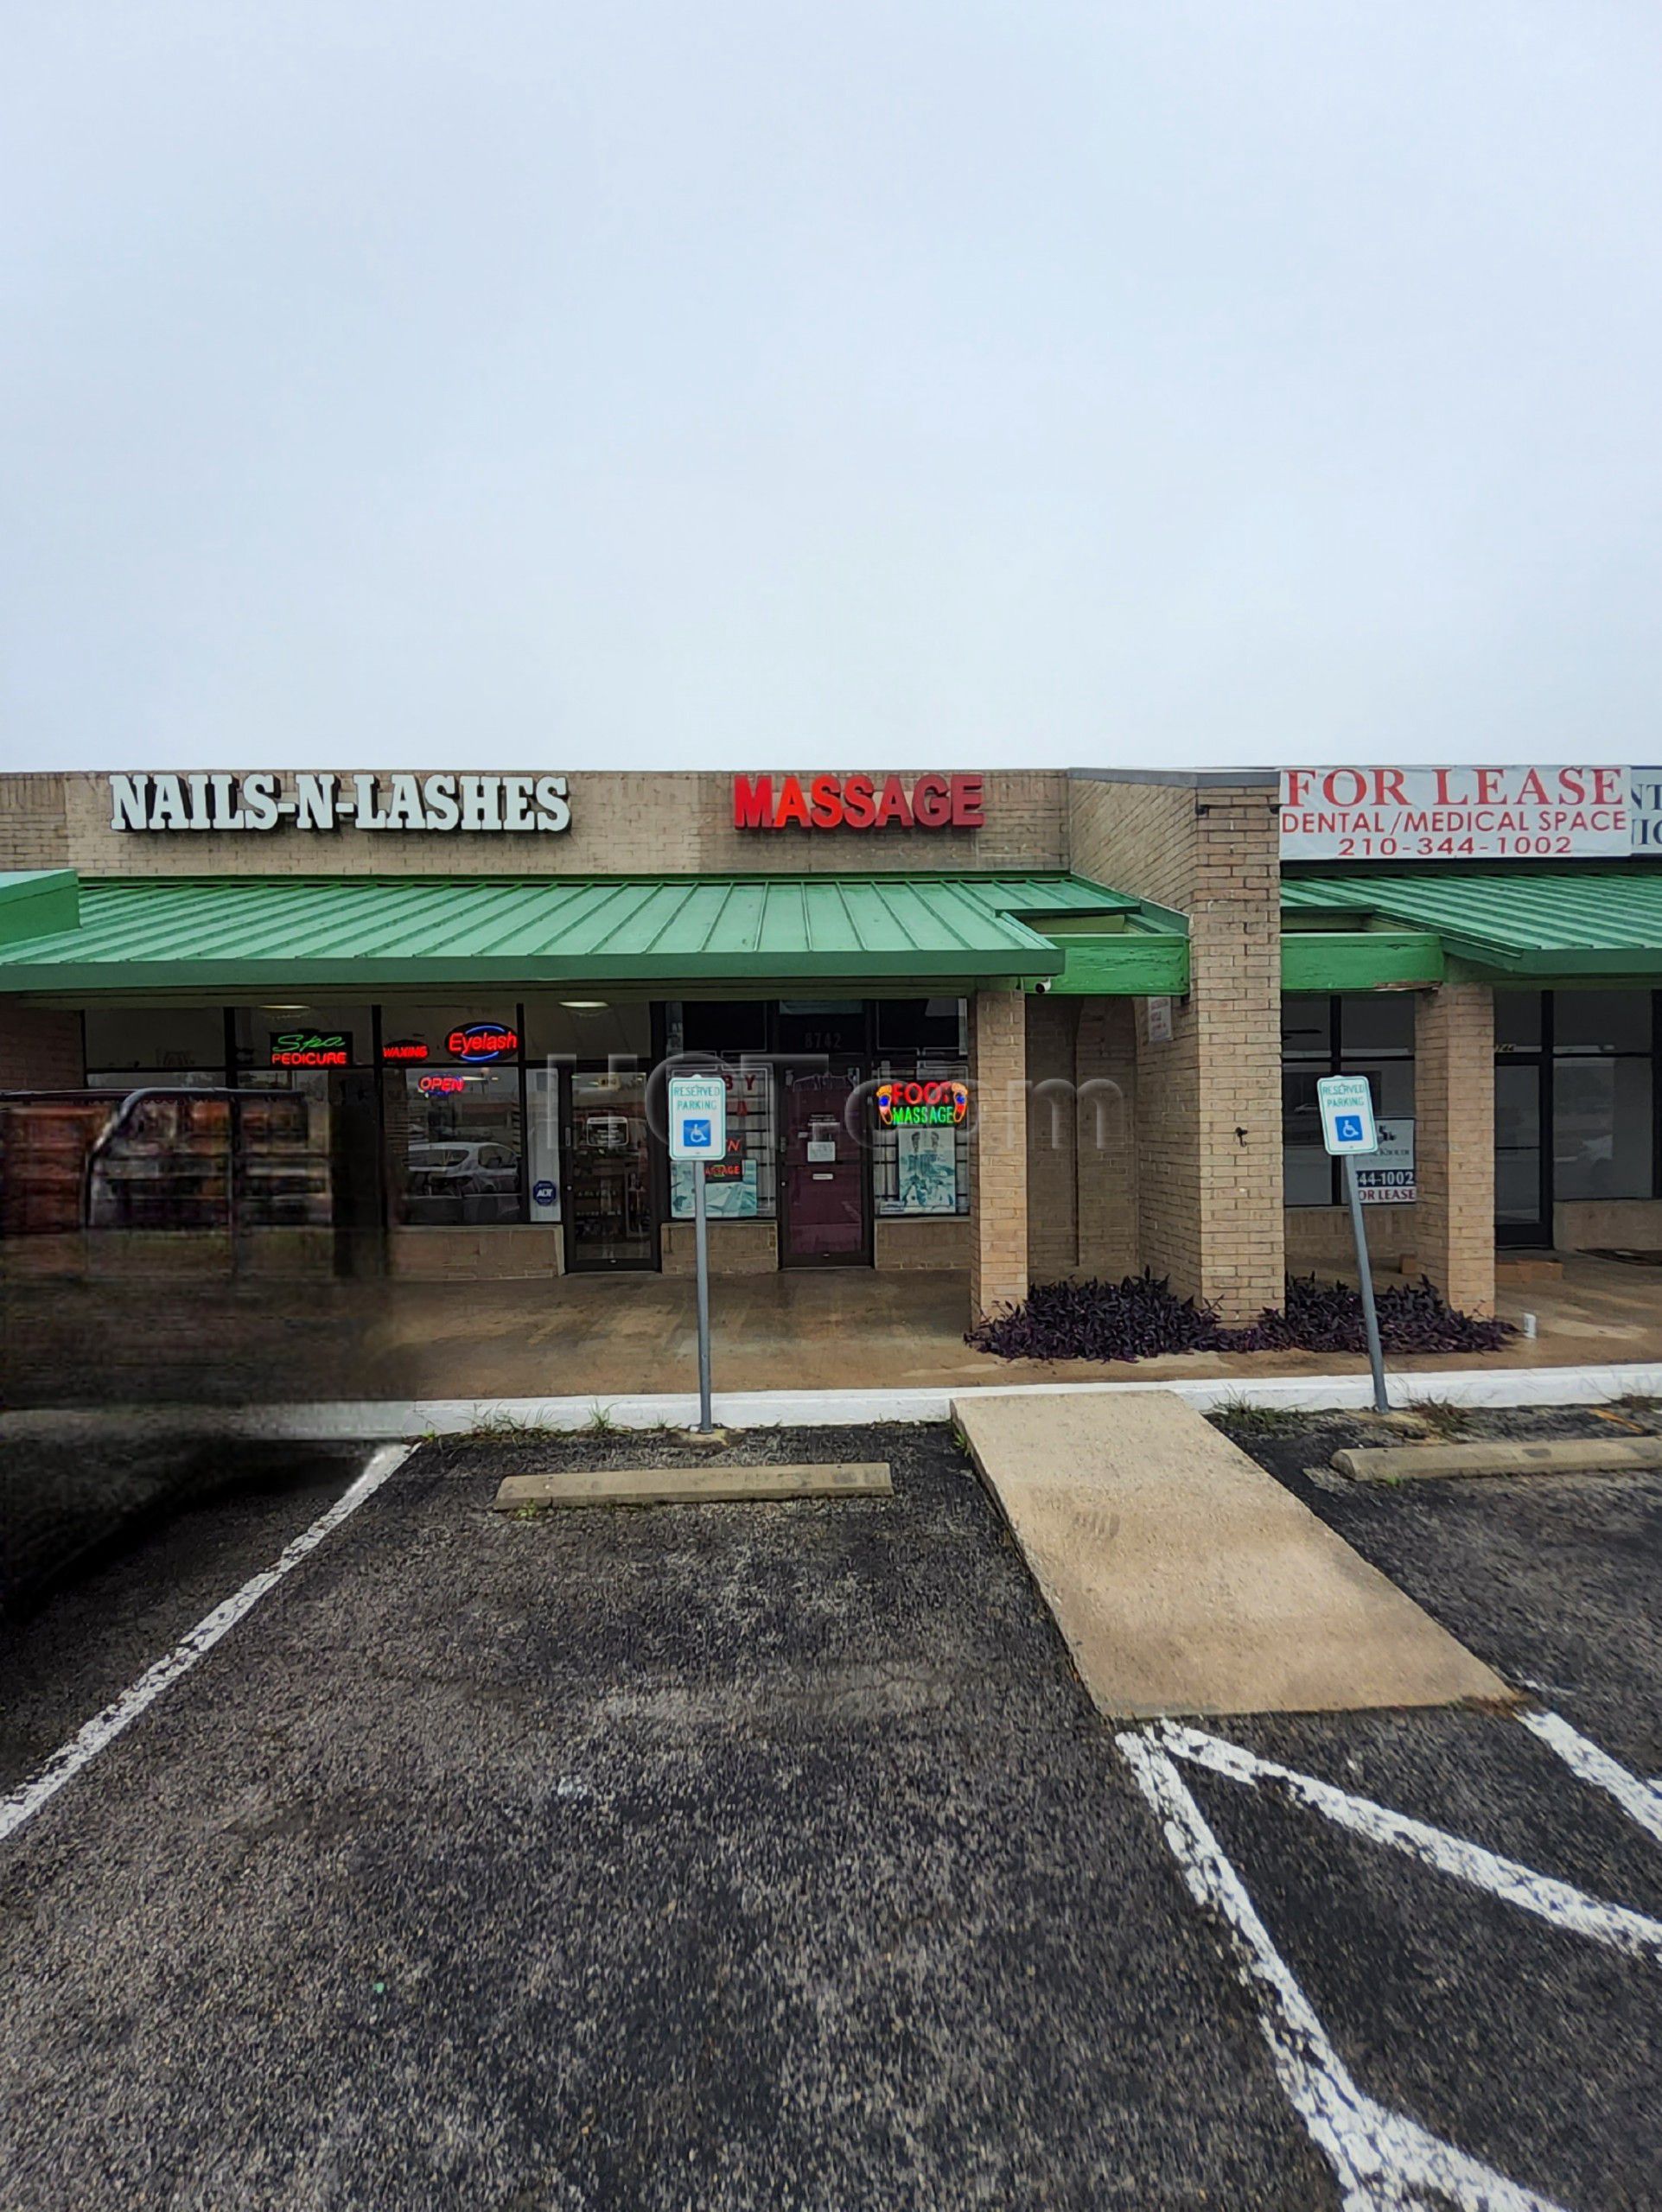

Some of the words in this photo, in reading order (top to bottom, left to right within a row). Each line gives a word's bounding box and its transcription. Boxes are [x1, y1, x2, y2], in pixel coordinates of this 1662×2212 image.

[1283, 767, 1412, 808] FOR
[1432, 766, 1624, 806] LEASE
[109, 774, 571, 832] NAILS-N-LASHES
[735, 773, 984, 830] MASSAGE
[1538, 809, 1627, 831] SPACE
[1337, 836, 1573, 856] 210-344-1002
[272, 1033, 347, 1052] Spa
[448, 1031, 518, 1055] Eyelash
[805, 1032, 841, 1049] 8742
[271, 1052, 347, 1065] PEDICURE
[383, 1046, 429, 1058] WAXING
[420, 1077, 465, 1091] OPEN
[674, 1085, 721, 1096] RESERVED
[1322, 1084, 1366, 1094] RESERVED
[891, 1082, 952, 1104] FOOT
[1327, 1096, 1365, 1107] PARKING
[677, 1100, 717, 1110] PARKING
[893, 1106, 954, 1123] MASSAGE
[1356, 1171, 1414, 1185] 44-1002
[1379, 1189, 1414, 1200] LEASE
